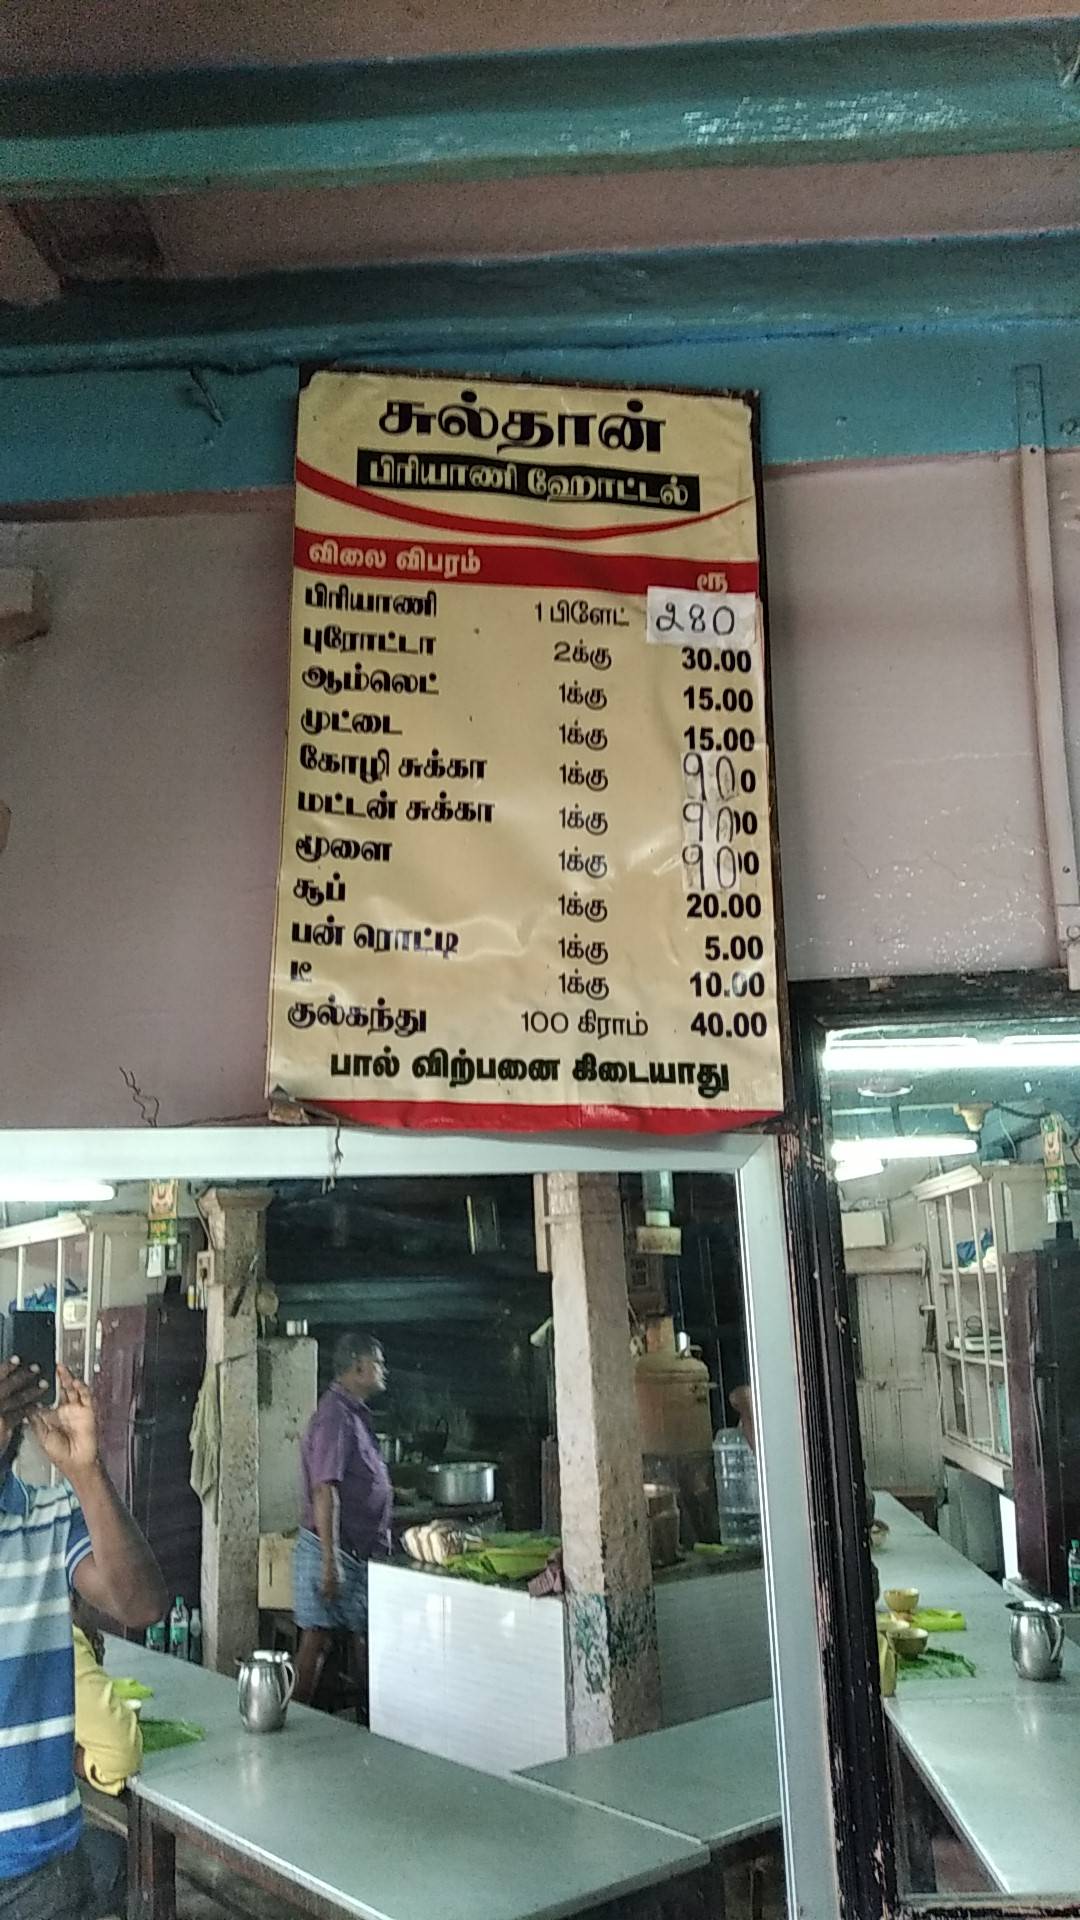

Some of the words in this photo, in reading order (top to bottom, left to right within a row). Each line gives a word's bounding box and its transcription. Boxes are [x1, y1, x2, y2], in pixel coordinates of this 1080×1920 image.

[378, 390, 666, 453] சுல்தான்
[369, 454, 518, 490] பிரியாணி
[528, 466, 688, 505] ஹோட்டல்
[309, 539, 387, 567] விலை
[396, 547, 481, 579] விபரம்
[304, 584, 437, 618] பிரியாணி
[534, 601, 543, 623] 1
[549, 600, 630, 628] பிளேட்
[655, 600, 736, 637] 280
[303, 626, 437, 657] புரோட்டா
[682, 646, 752, 673] 30.00
[302, 663, 439, 695] ஆம்லெட்
[683, 687, 753, 713] 15.00
[301, 705, 403, 735] முட்டை
[684, 728, 755, 752] 15.00
[300, 744, 390, 785] கோழி
[398, 748, 488, 780] சுக்கா
[297, 785, 398, 822] மட்டன்
[406, 789, 494, 823] சுக்கா
[295, 831, 392, 863] மூளை
[293, 870, 346, 905] சூப்
[686, 893, 762, 919] 20.00
[291, 916, 345, 946] பன்
[354, 920, 459, 959] ரொட்டி
[705, 936, 764, 961] 5.00
[689, 973, 765, 998] 10.00
[287, 995, 427, 1034] குல்கந்து
[522, 1011, 569, 1034] 100
[577, 1010, 649, 1040] கிராம்
[691, 1012, 767, 1038] 40.00
[330, 1045, 400, 1078] பால்
[412, 1049, 560, 1088] விற்பனை
[571, 1053, 729, 1098] கிடையாது
